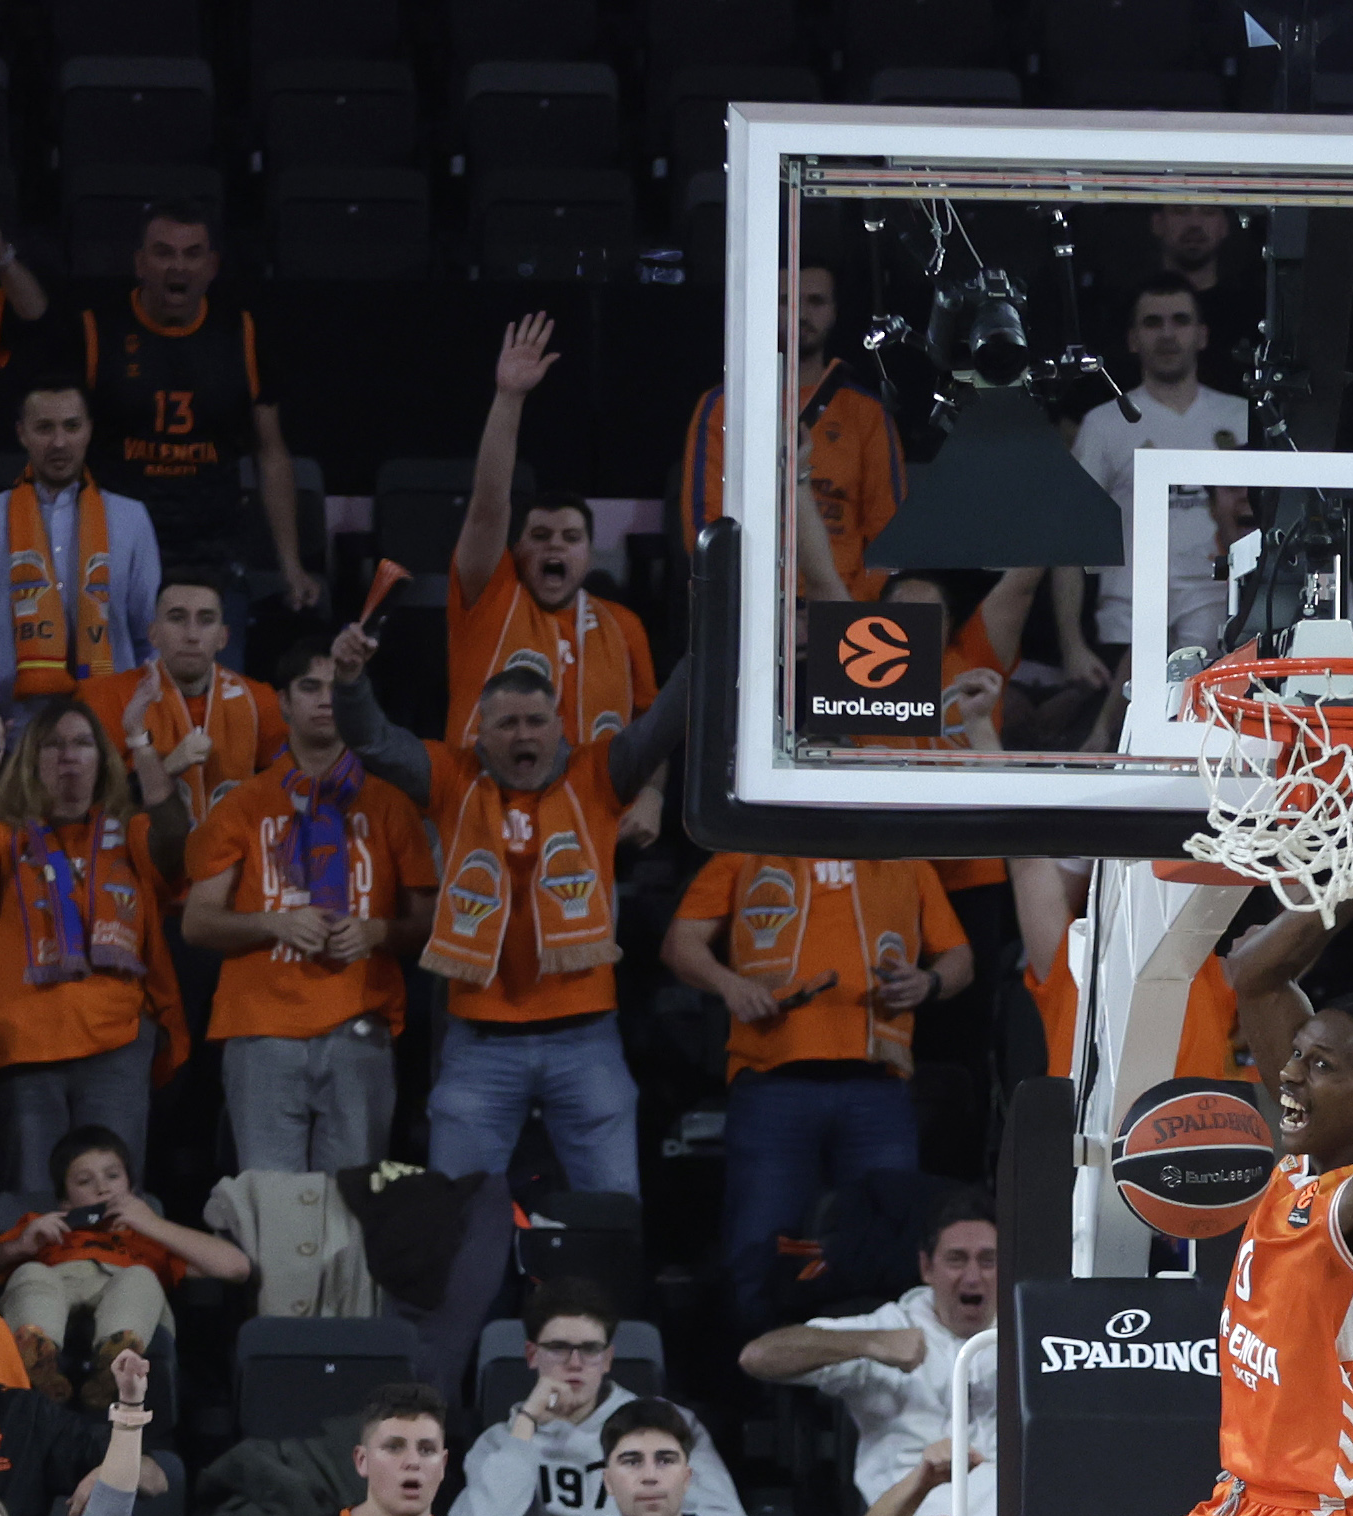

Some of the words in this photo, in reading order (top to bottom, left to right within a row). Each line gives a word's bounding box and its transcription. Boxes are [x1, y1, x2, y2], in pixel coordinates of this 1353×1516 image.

[154, 390, 195, 435] 13
[14, 620, 54, 640] BC
[812, 696, 935, 722] EuroLeague
[1152, 1112, 1265, 1144] SPALDING
[1041, 1335, 1221, 1377] SPALDING
